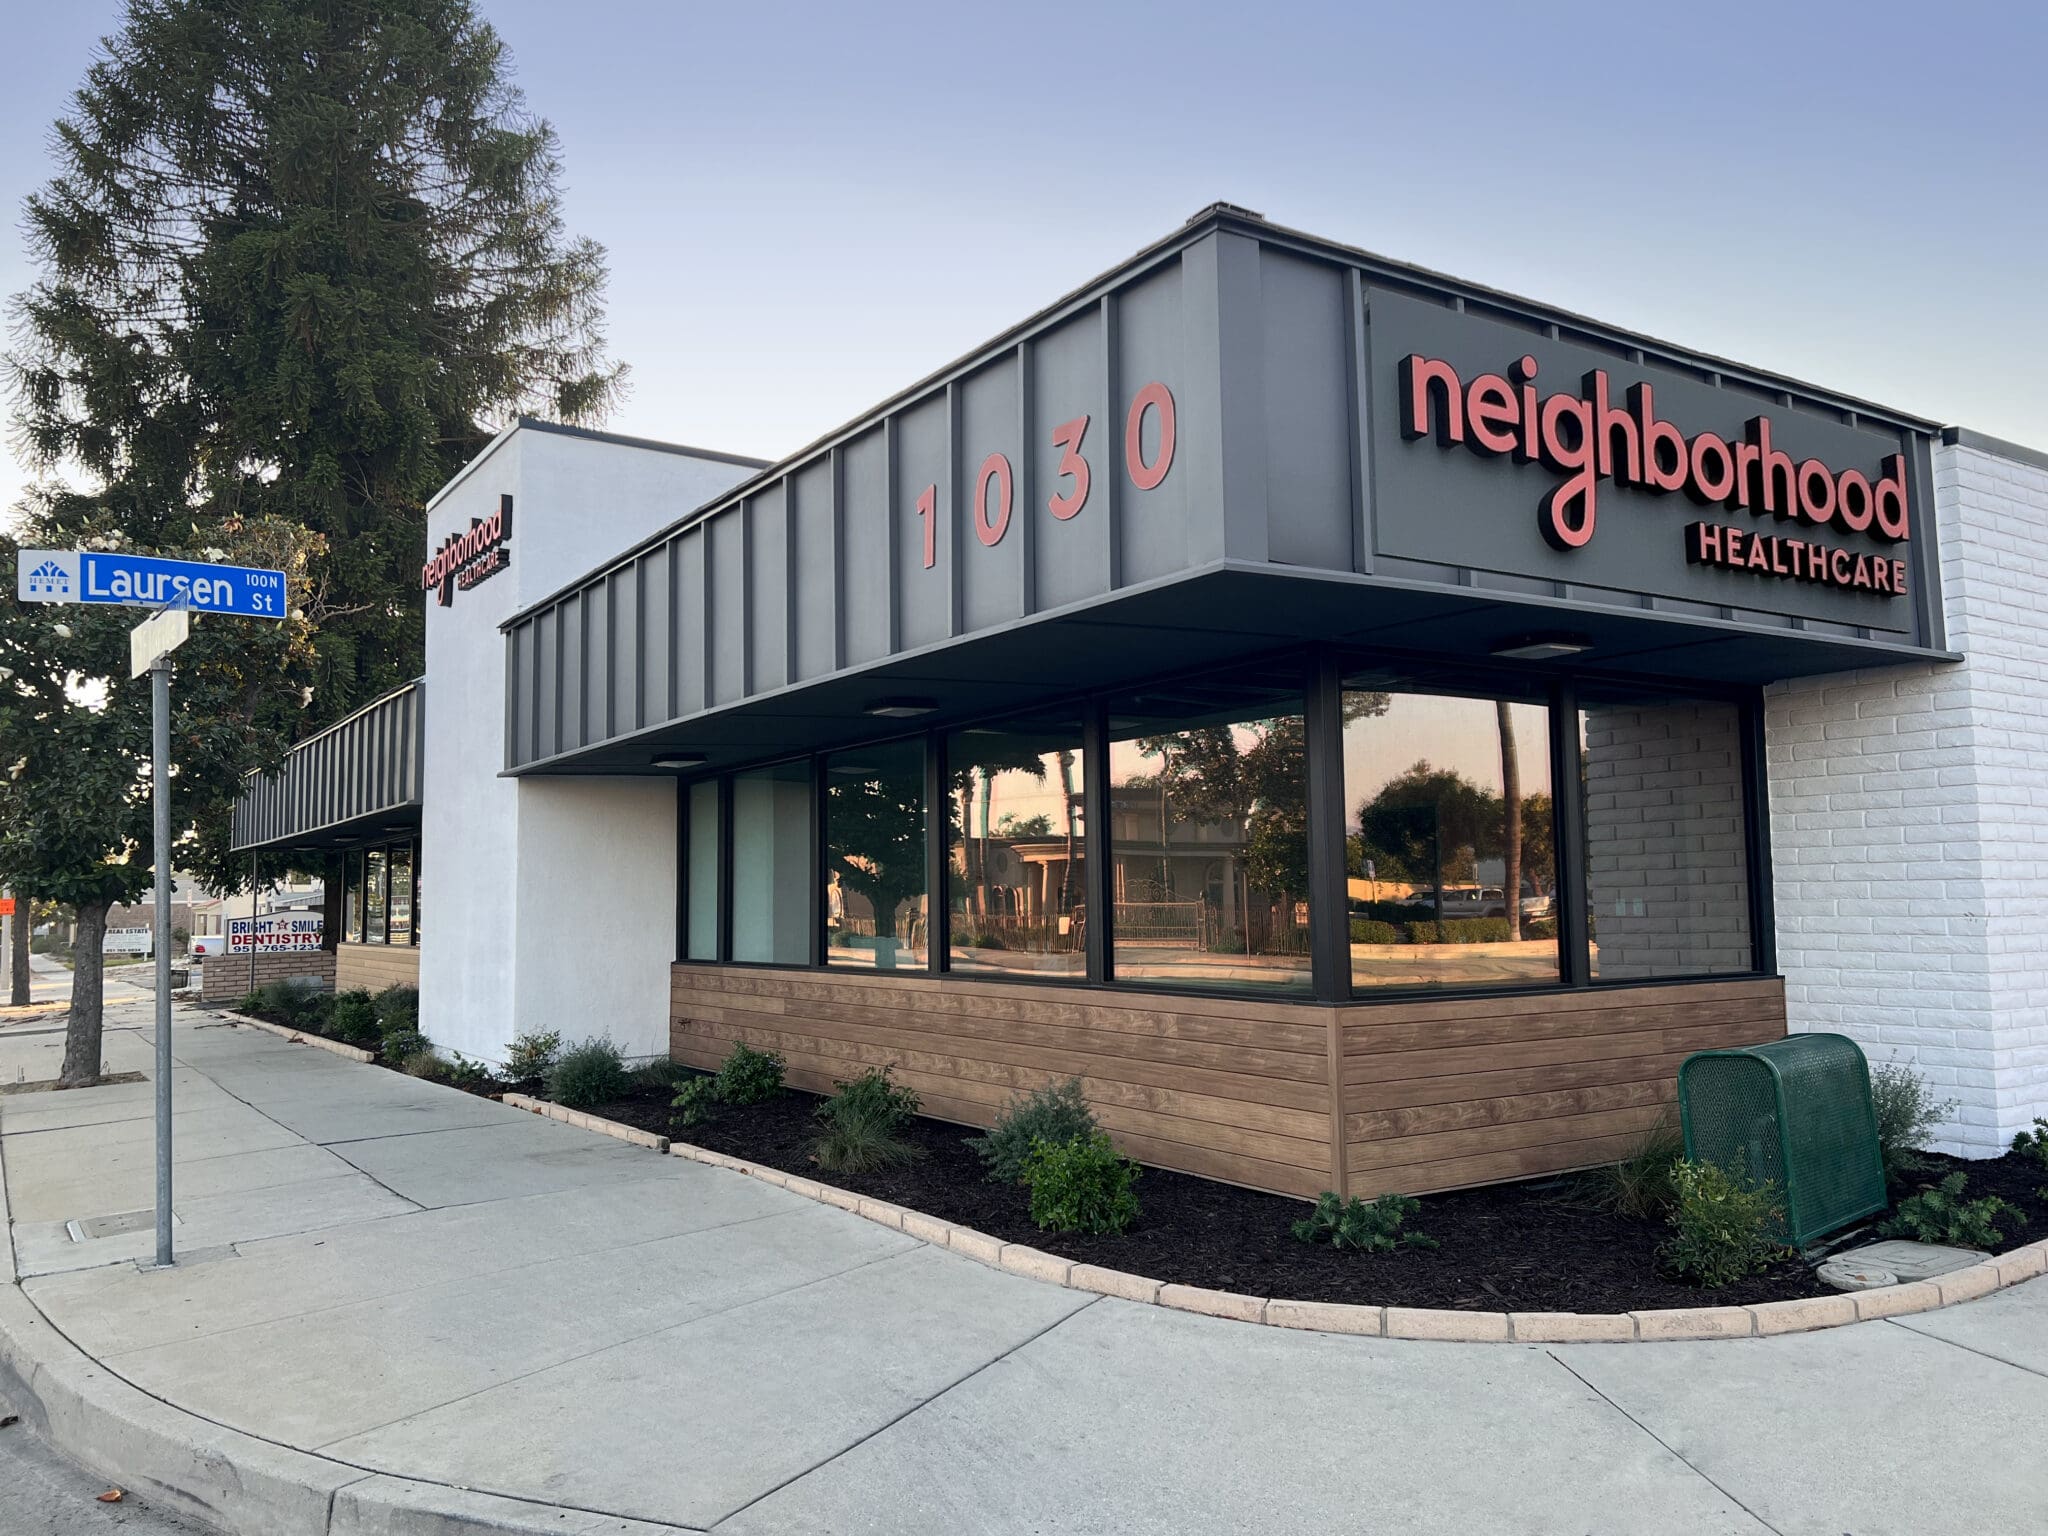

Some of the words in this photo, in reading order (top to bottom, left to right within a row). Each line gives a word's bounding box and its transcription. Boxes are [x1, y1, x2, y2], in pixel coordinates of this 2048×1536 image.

[1401, 354, 1909, 549] neighborhood
[422, 494, 508, 607] neighborhood
[458, 550, 504, 589] HEALTHCARE
[1694, 522, 1908, 595] HEALTHCARE
[88, 560, 233, 606] Laursen
[251, 593, 273, 612] St
[231, 921, 273, 933] BRIGHT
[231, 933, 321, 945] DENTISTRY
